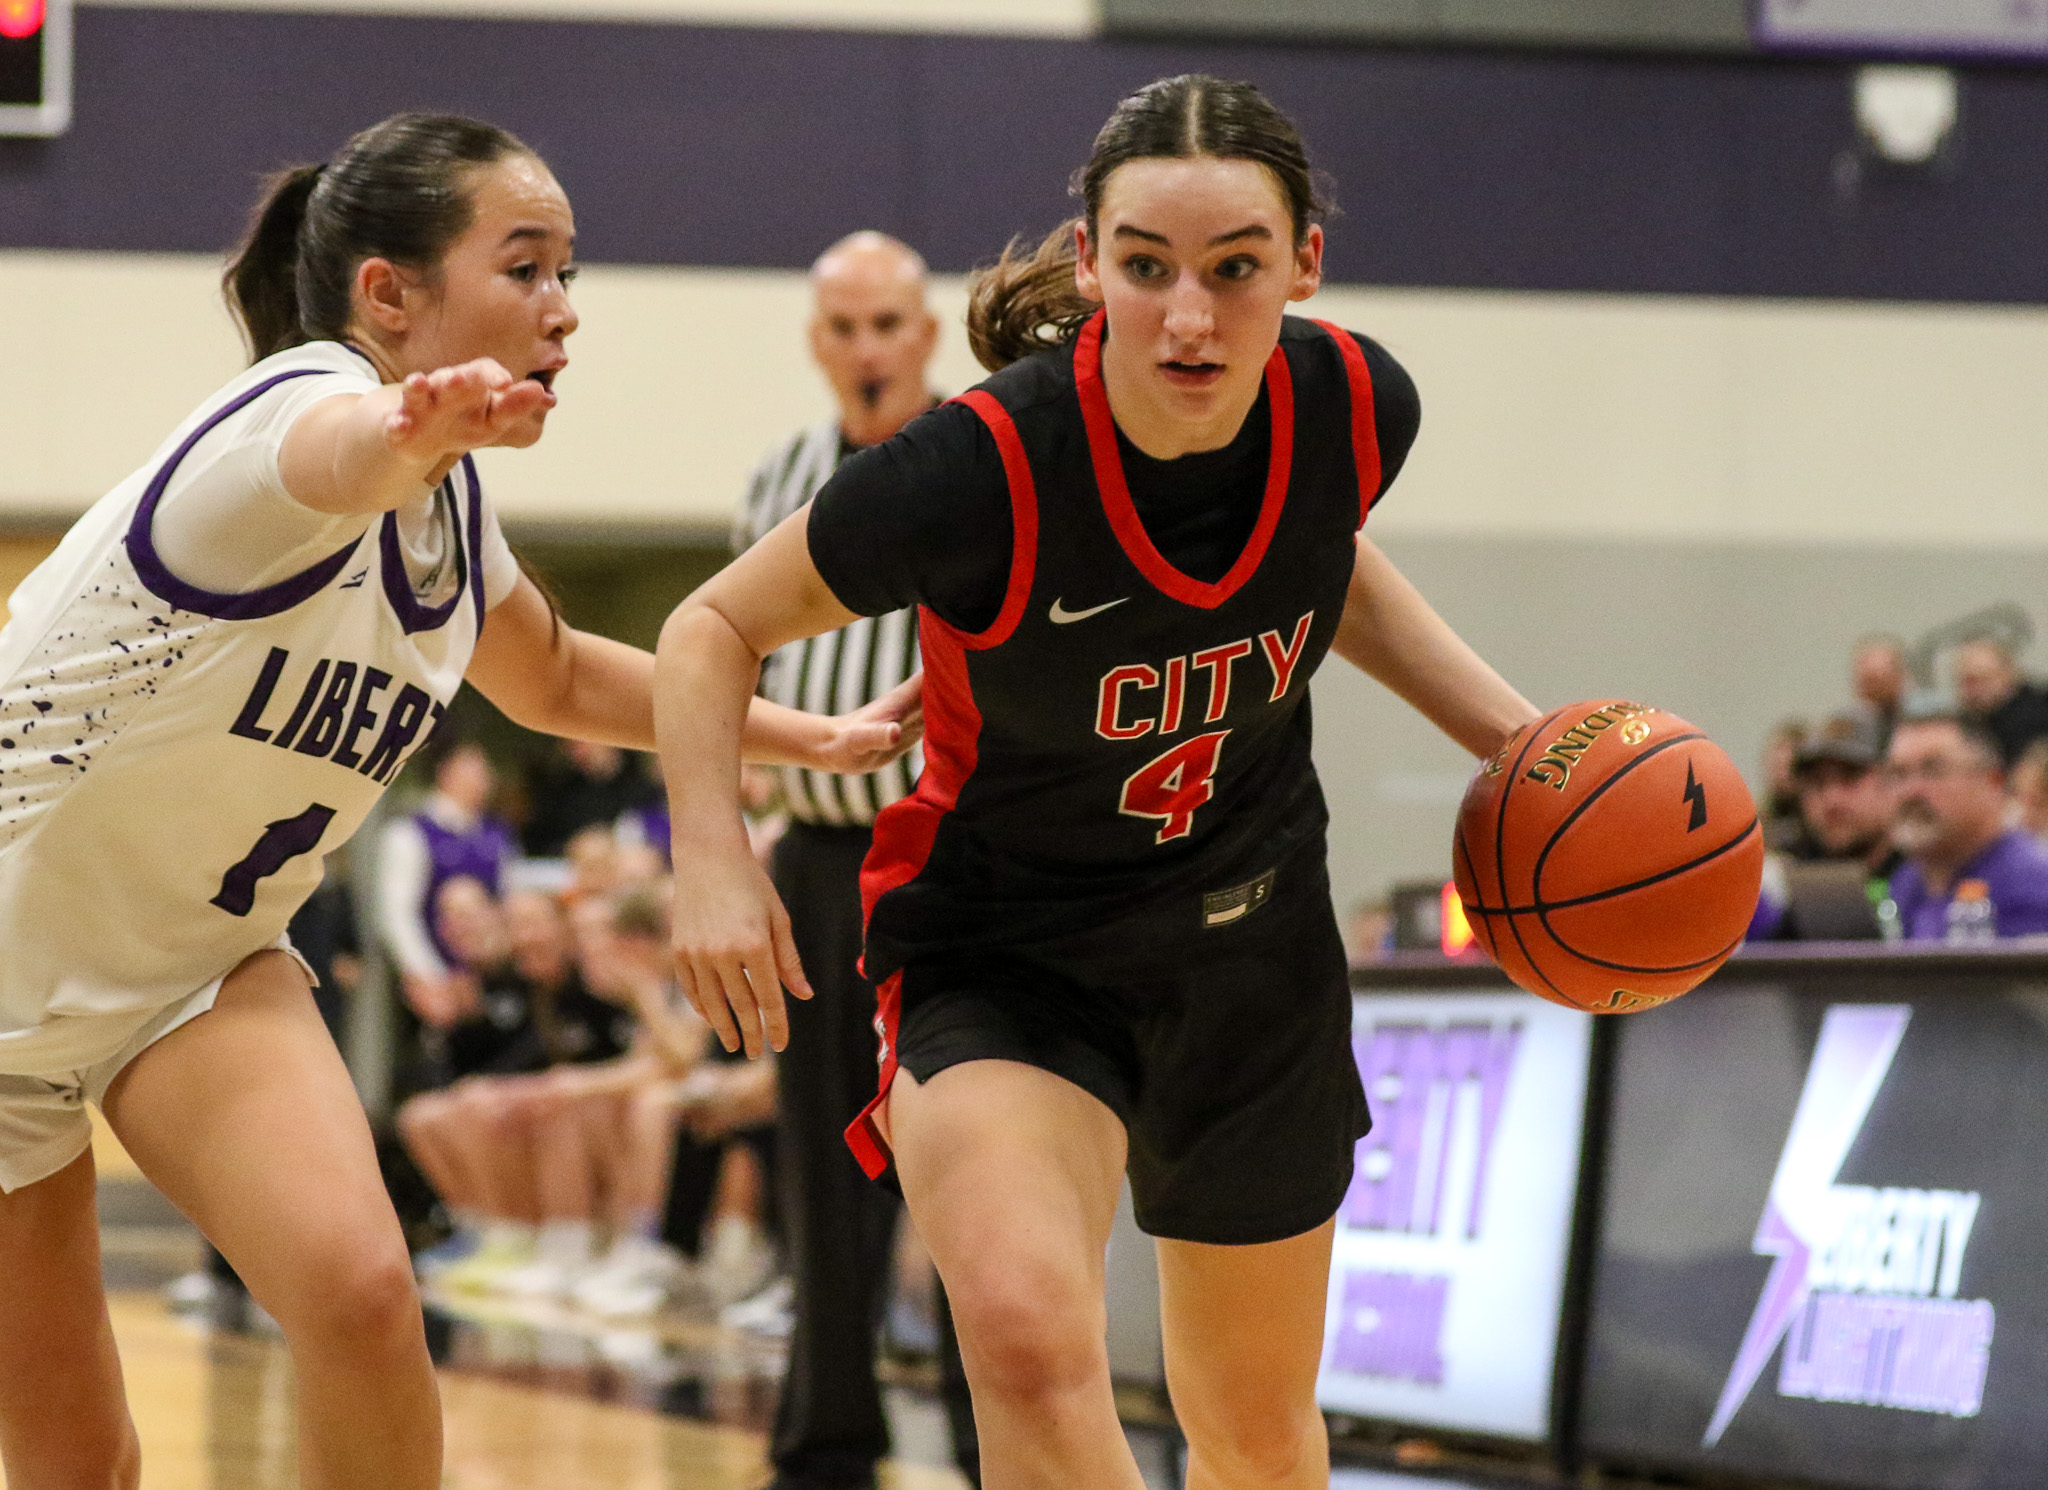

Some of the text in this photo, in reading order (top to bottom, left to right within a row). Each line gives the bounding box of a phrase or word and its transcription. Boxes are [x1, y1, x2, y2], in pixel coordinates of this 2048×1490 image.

[1094, 609, 1315, 741] CITY
[1117, 728, 1234, 845] 4
[208, 802, 338, 917] 1
